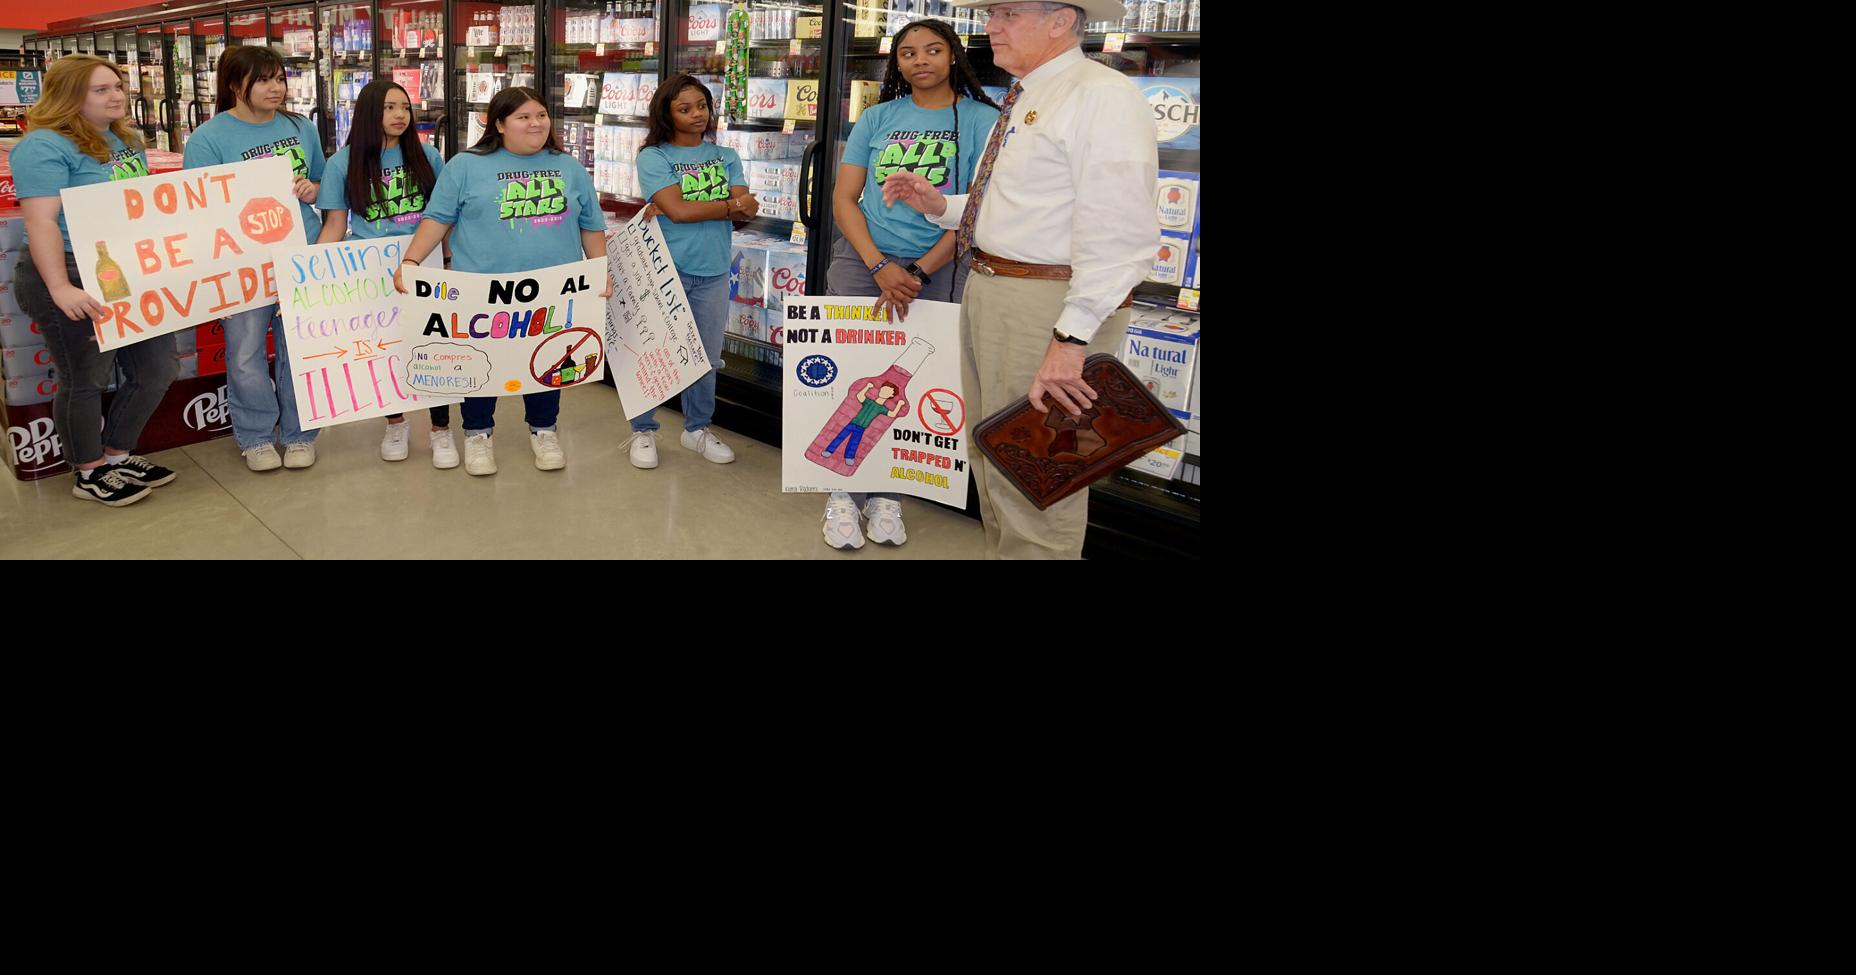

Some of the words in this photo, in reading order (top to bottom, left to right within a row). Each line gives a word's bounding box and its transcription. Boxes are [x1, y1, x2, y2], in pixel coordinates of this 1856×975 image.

[1153, 104, 1199, 124] SCH
[241, 136, 300, 161] DRUG-FREE
[880, 142, 941, 166] ALL
[497, 170, 562, 180] DRUG-FREE
[123, 172, 236, 221] DON'T
[506, 179, 559, 200] ALL
[500, 196, 566, 219] STARS
[1158, 205, 1186, 216] Natural
[248, 207, 284, 235] STOP
[135, 232, 193, 276] BE
[213, 228, 244, 260] A
[292, 276, 394, 310] ALCOHOL
[488, 278, 539, 305] NO
[560, 275, 590, 295] AL
[423, 299, 574, 339] ALCOHOL!
[787, 305, 807, 320] BE
[810, 305, 821, 320] A
[352, 338, 375, 356] IS
[786, 328, 819, 344] NOT
[821, 328, 832, 344] A
[835, 328, 907, 346] DRINKER
[412, 373, 477, 389] MENORES!!
[1154, 363, 1179, 378] Light
[893, 428, 932, 445] DON'T
[934, 435, 959, 451] GET
[892, 447, 951, 470] TRAPPED
[890, 466, 950, 489] ALCOHOL
